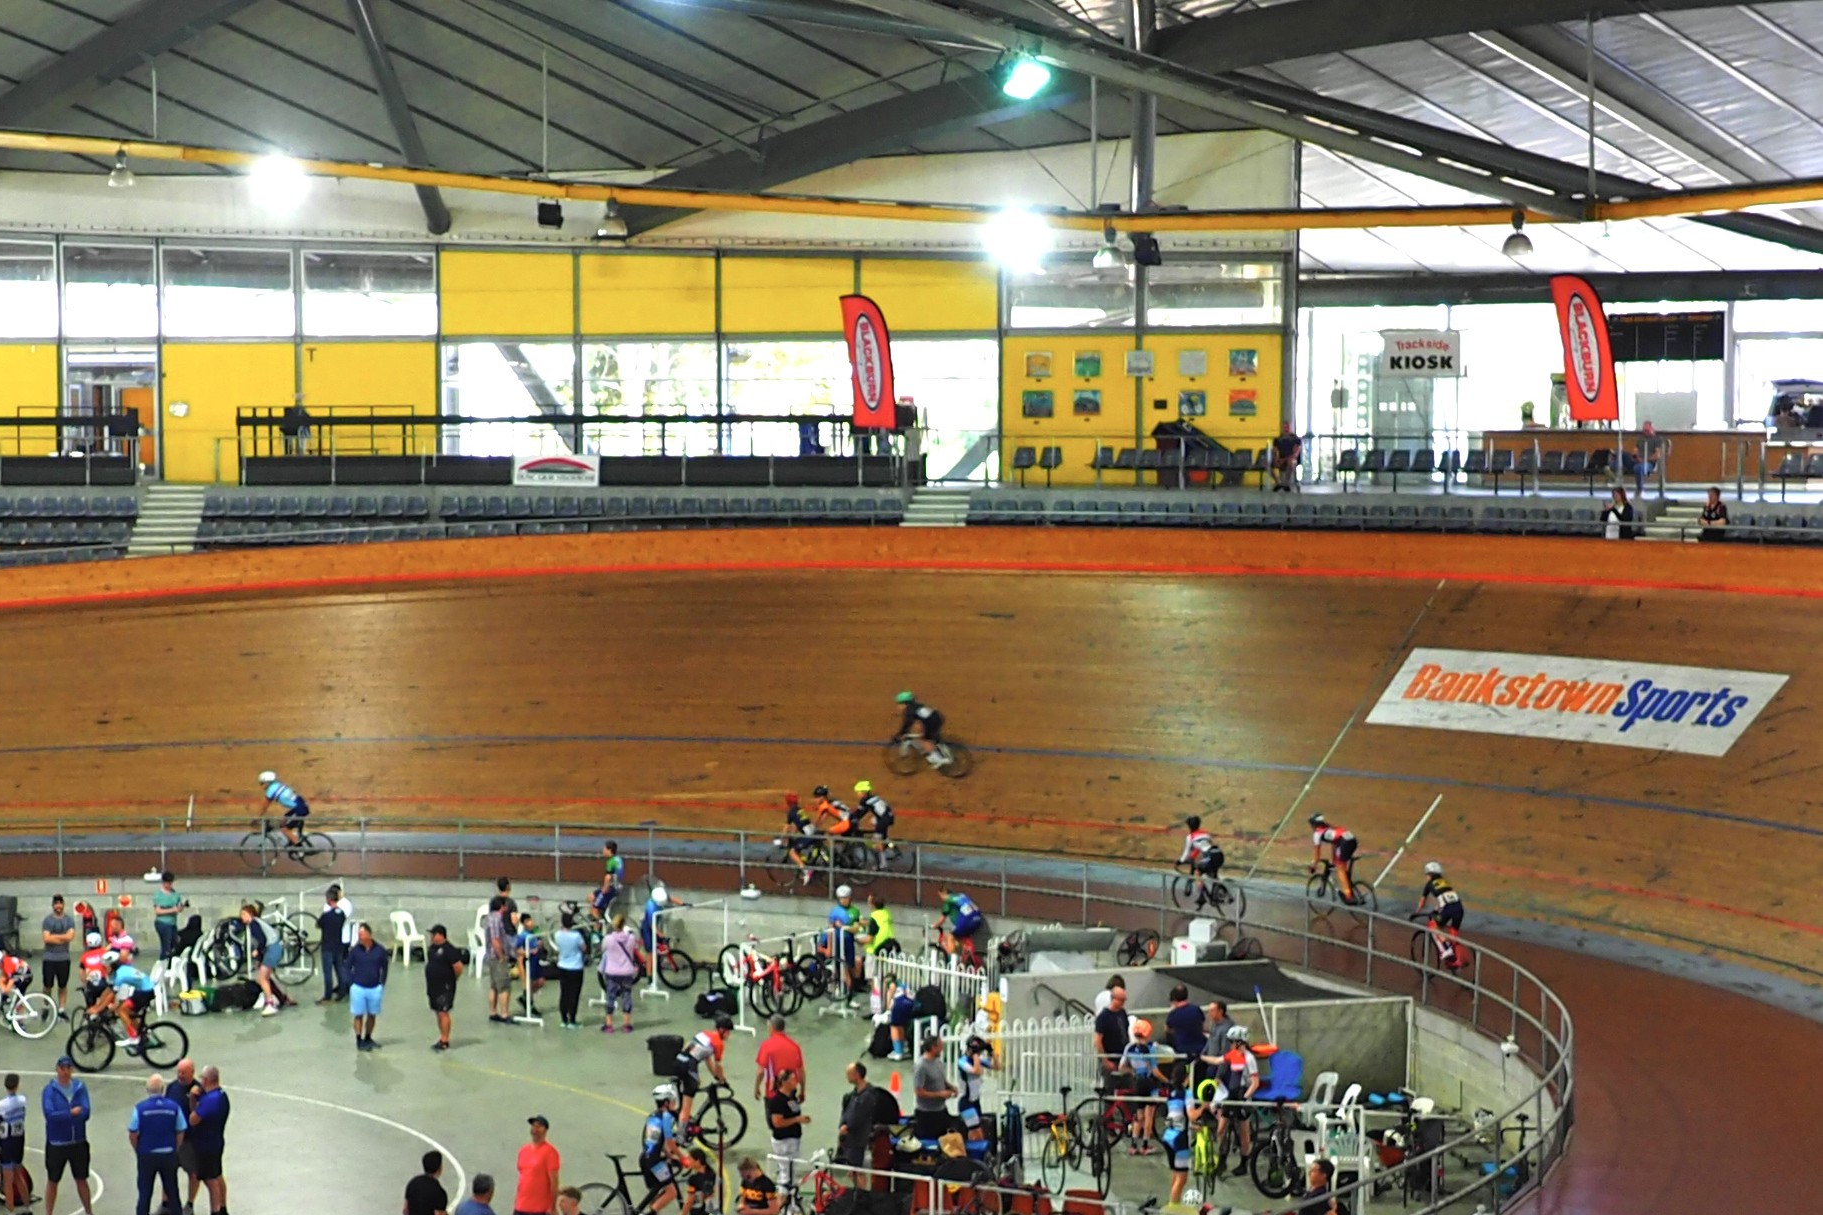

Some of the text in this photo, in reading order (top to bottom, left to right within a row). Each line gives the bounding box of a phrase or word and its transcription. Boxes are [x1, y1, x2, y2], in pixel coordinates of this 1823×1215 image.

[859, 321, 877, 403] BLACKBURN
[1390, 355, 1453, 370] KIOSK
[1395, 338, 1451, 352] Trackside
[1572, 302, 1596, 393] BLACKBURN
